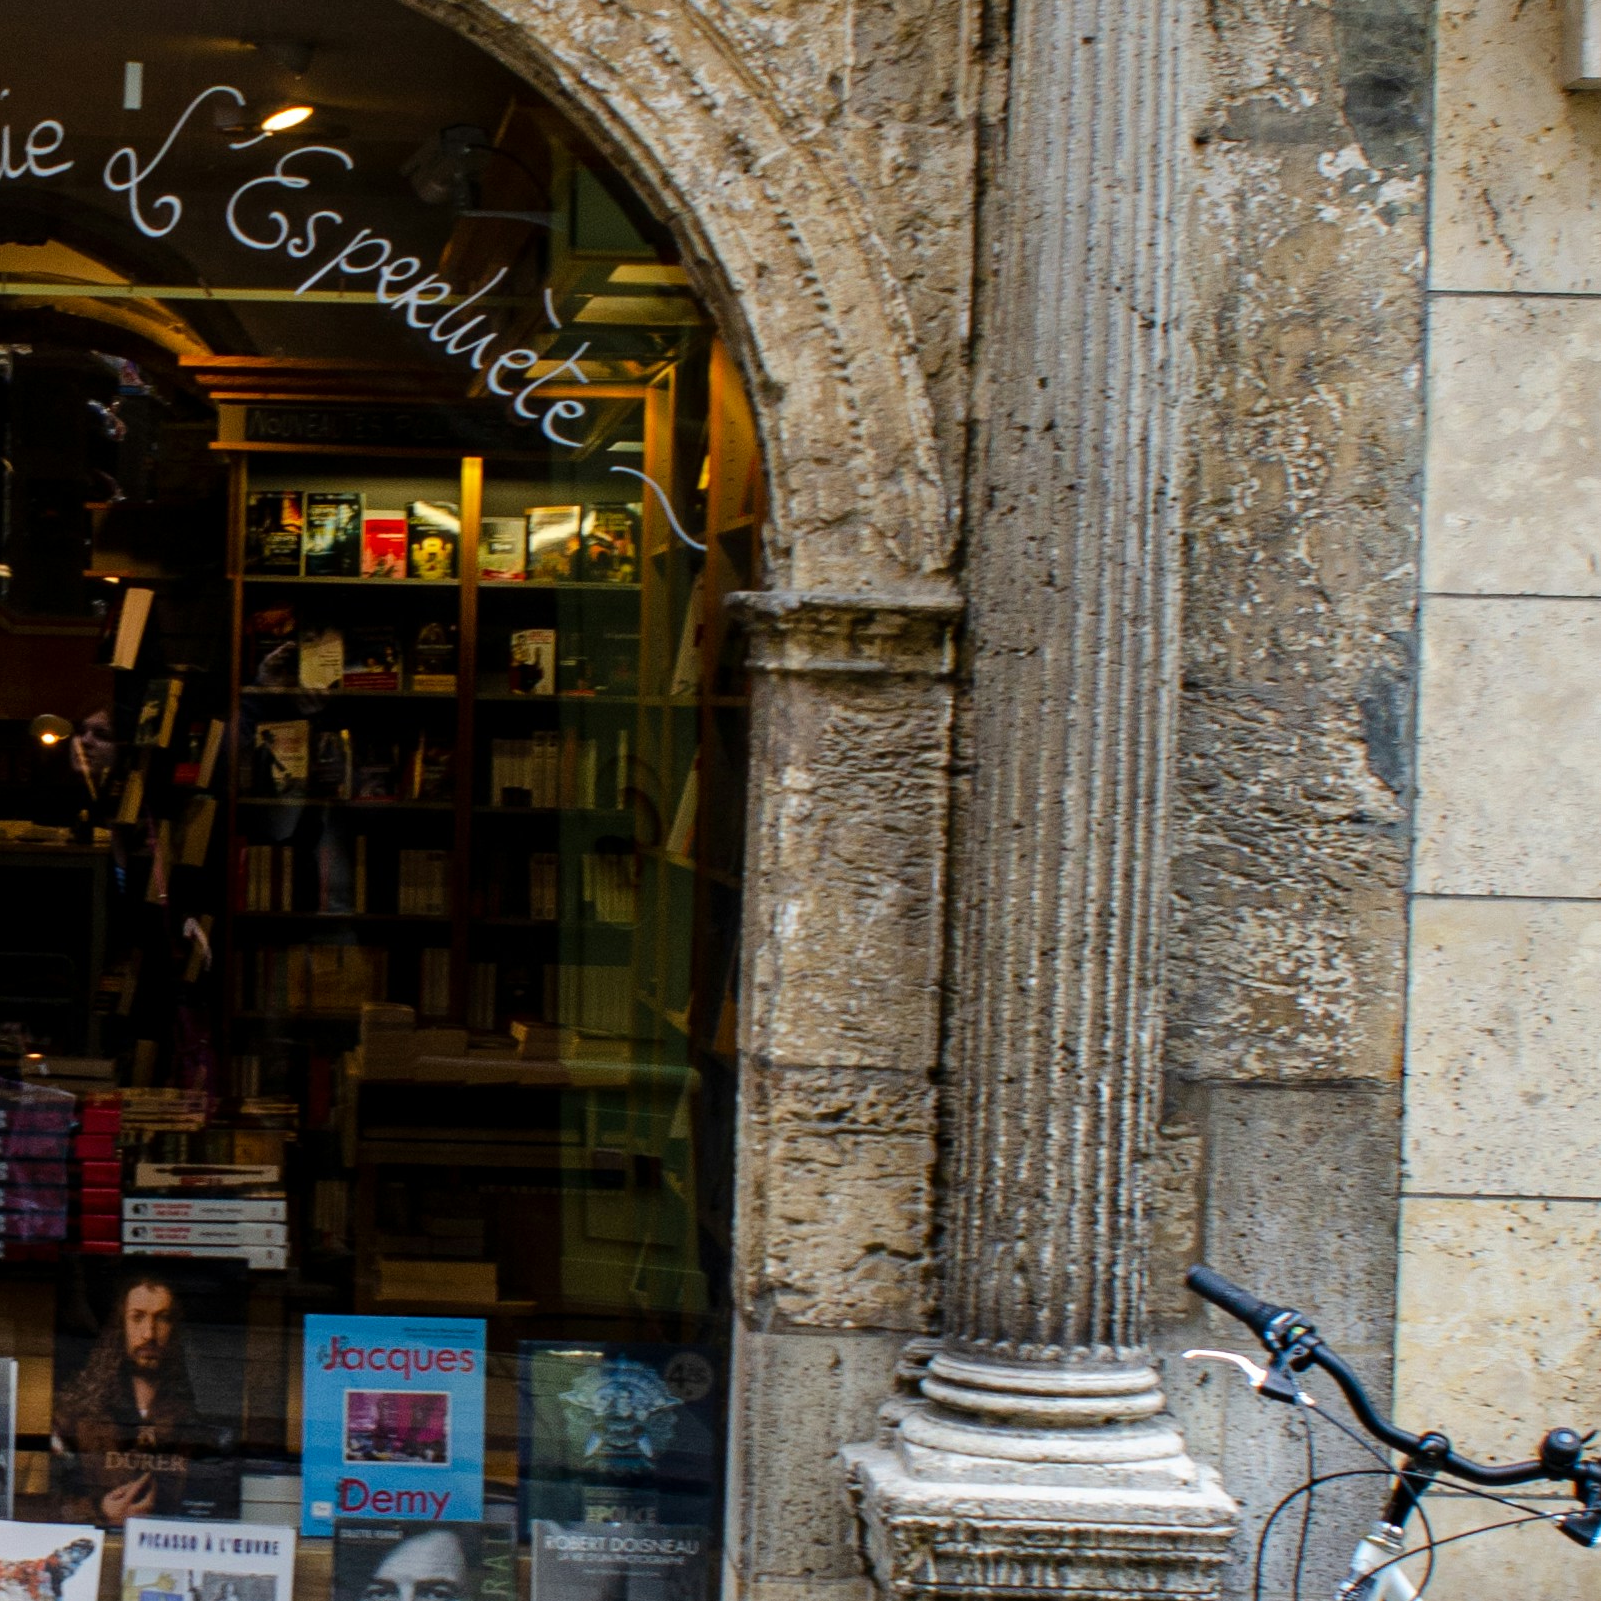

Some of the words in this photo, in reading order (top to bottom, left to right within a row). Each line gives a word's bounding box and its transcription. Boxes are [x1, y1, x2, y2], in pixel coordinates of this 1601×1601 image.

[323, 1335, 476, 1381] Jacques
[338, 1477, 451, 1520] Demy
[138, 1531, 197, 1550] PICASSO
[543, 1534, 607, 1550] ROBERT
[610, 1537, 700, 1556] DOISNEAU
